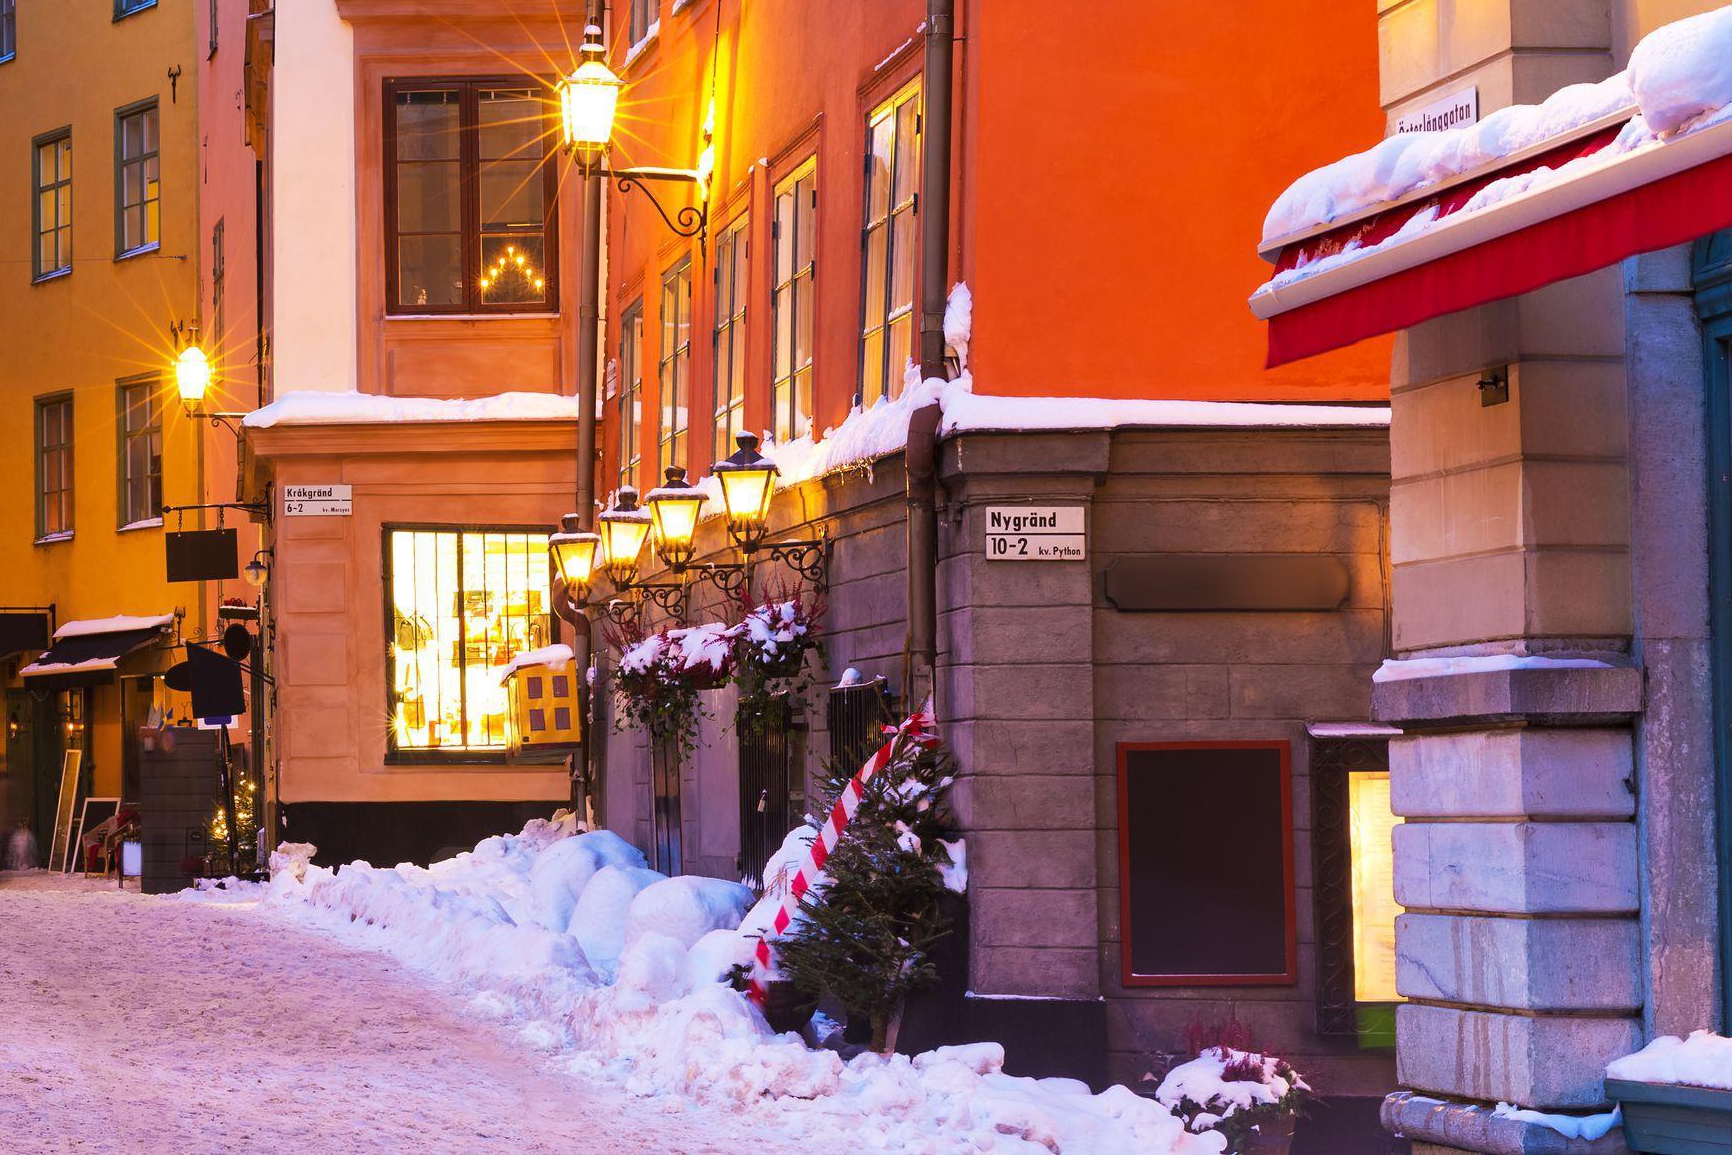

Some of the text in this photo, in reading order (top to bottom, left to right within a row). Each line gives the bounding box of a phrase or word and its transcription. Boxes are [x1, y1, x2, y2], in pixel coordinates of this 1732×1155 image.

[287, 488, 333, 499] Kråkgränd
[287, 503, 303, 513] 6-2
[991, 512, 1056, 532] Nygränd
[991, 538, 1081, 557] 10-2 kv. Python
